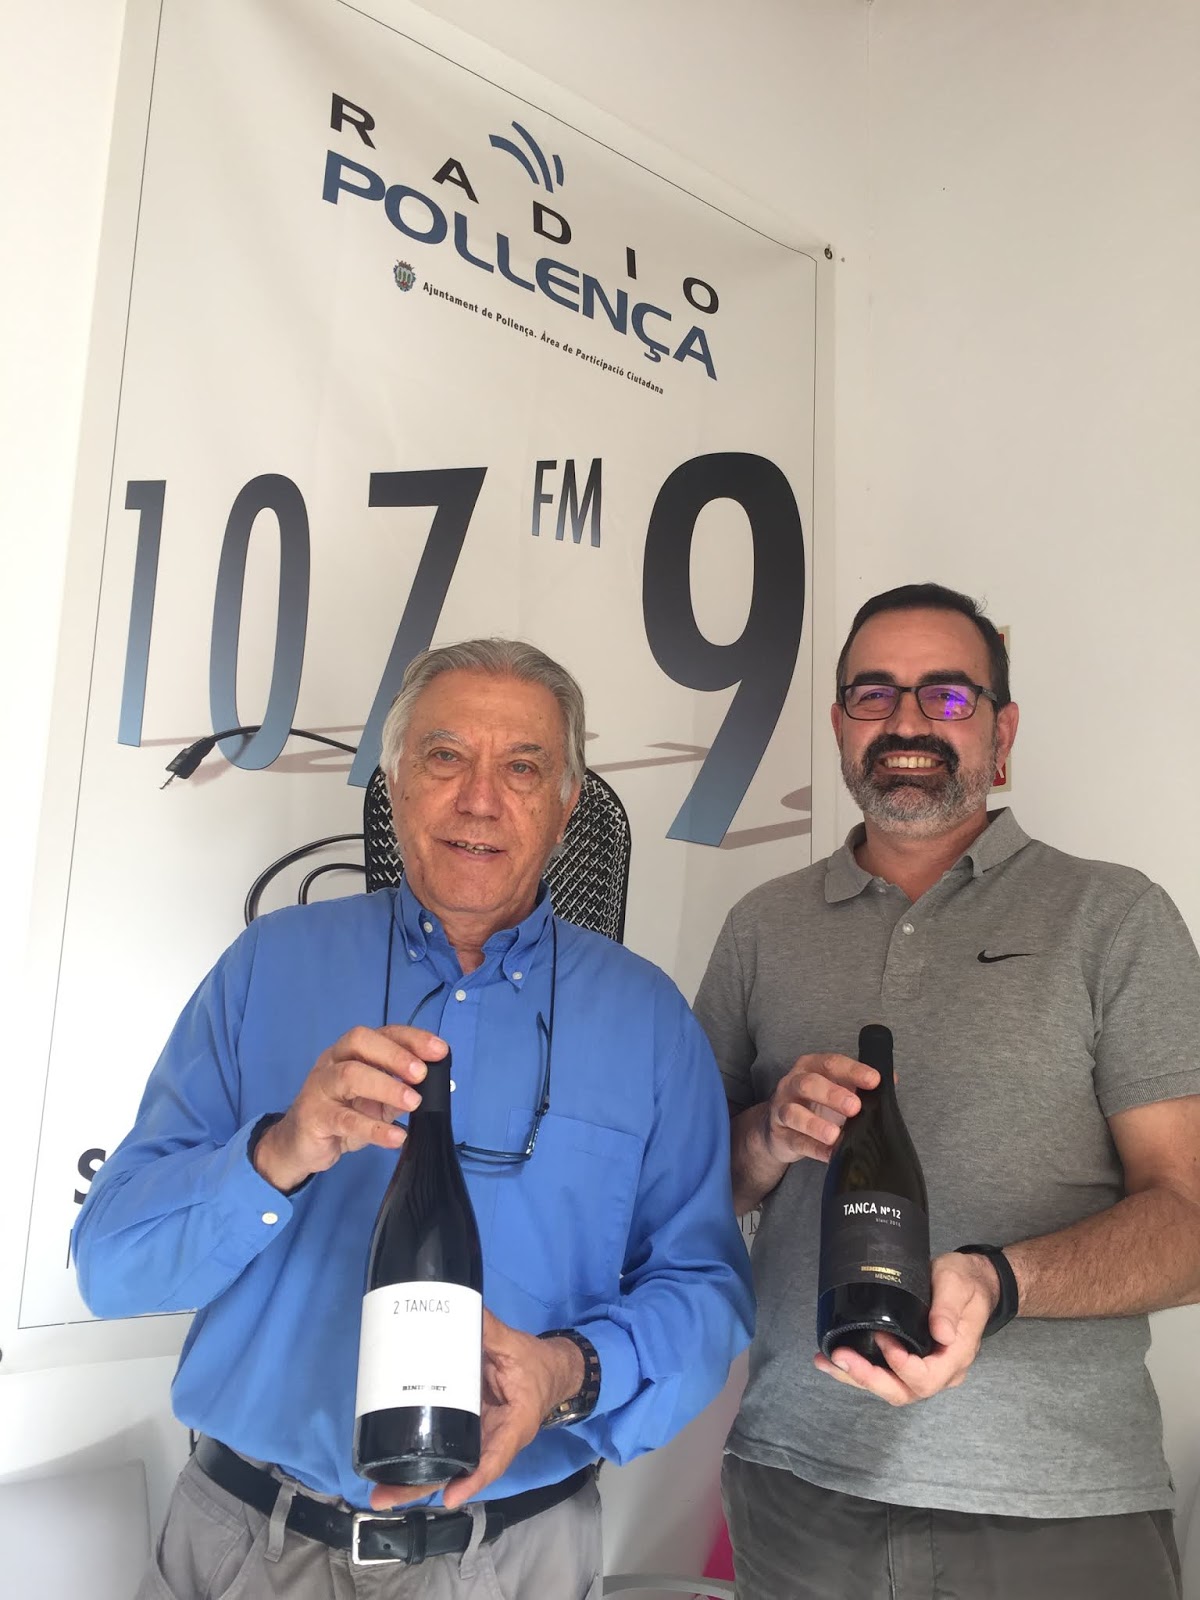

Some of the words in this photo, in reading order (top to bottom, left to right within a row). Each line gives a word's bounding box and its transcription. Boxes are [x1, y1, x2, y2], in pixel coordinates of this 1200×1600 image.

[322, 149, 718, 381] POLLENÇA
[330, 92, 720, 315] RADIO
[423, 282, 478, 313] Ajuntament
[481, 307, 493, 319] de
[496, 312, 537, 337] Pollença.
[562, 343, 573, 354] de
[575, 348, 624, 376] Participació
[626, 371, 664, 394] Ciutadana
[531, 458, 602, 548] FM
[642, 451, 806, 848] 9
[843, 1202, 878, 1216] TANCA
[891, 1208, 901, 1220] 12
[393, 1300, 400, 1315] 2
[405, 1298, 451, 1314] TANCAS
